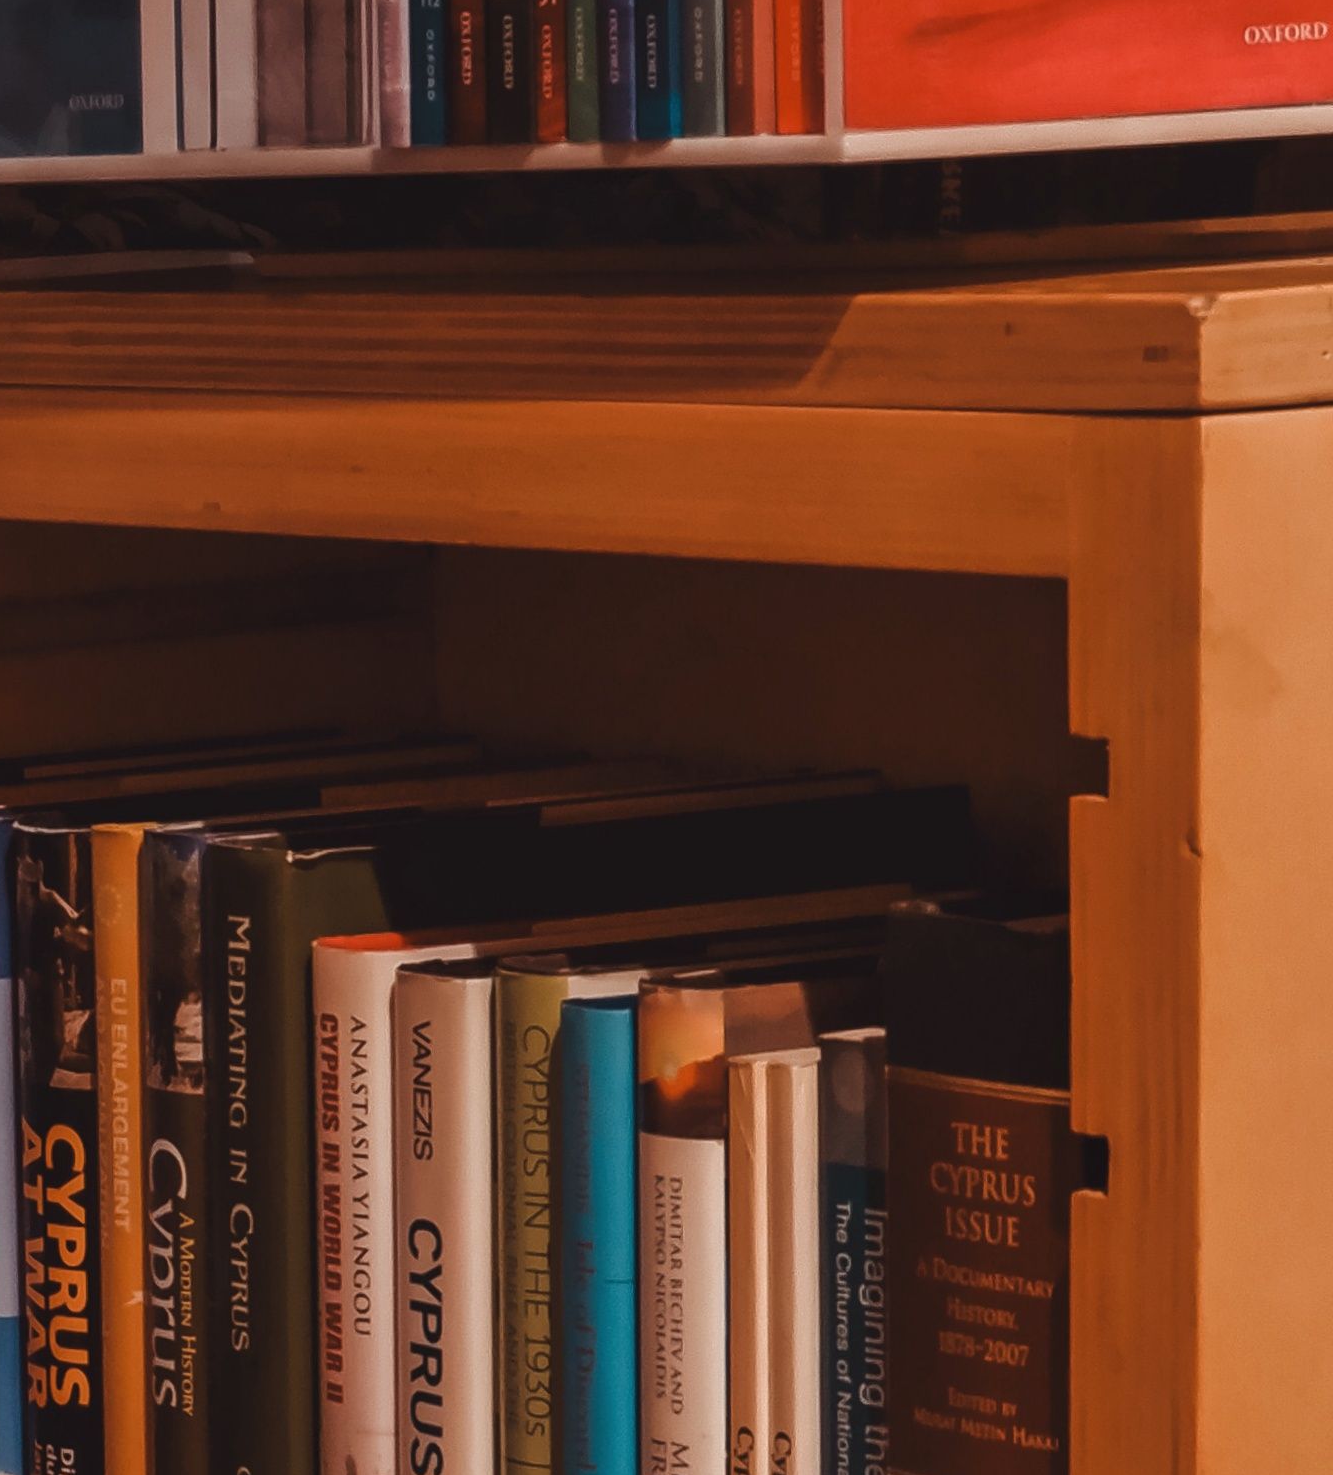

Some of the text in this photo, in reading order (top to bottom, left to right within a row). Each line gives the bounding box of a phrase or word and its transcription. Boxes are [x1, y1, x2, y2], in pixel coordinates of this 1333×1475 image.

[460, 12, 473, 85] OXFORD
[541, 25, 554, 98] OXFORD
[1244, 21, 1328, 44] OXFORD
[412, 1021, 434, 1161] VANEZIS
[351, 1016, 371, 1337] ANASTASIA YIANGOU
[950, 1121, 1010, 1162] THE
[320, 1013, 344, 1403] CYPRUS IN WORLD WAR II
[930, 1162, 1037, 1207] CYPRUS
[944, 1207, 1021, 1248] ISSUE
[45, 1124, 89, 1406] CYPRUS
